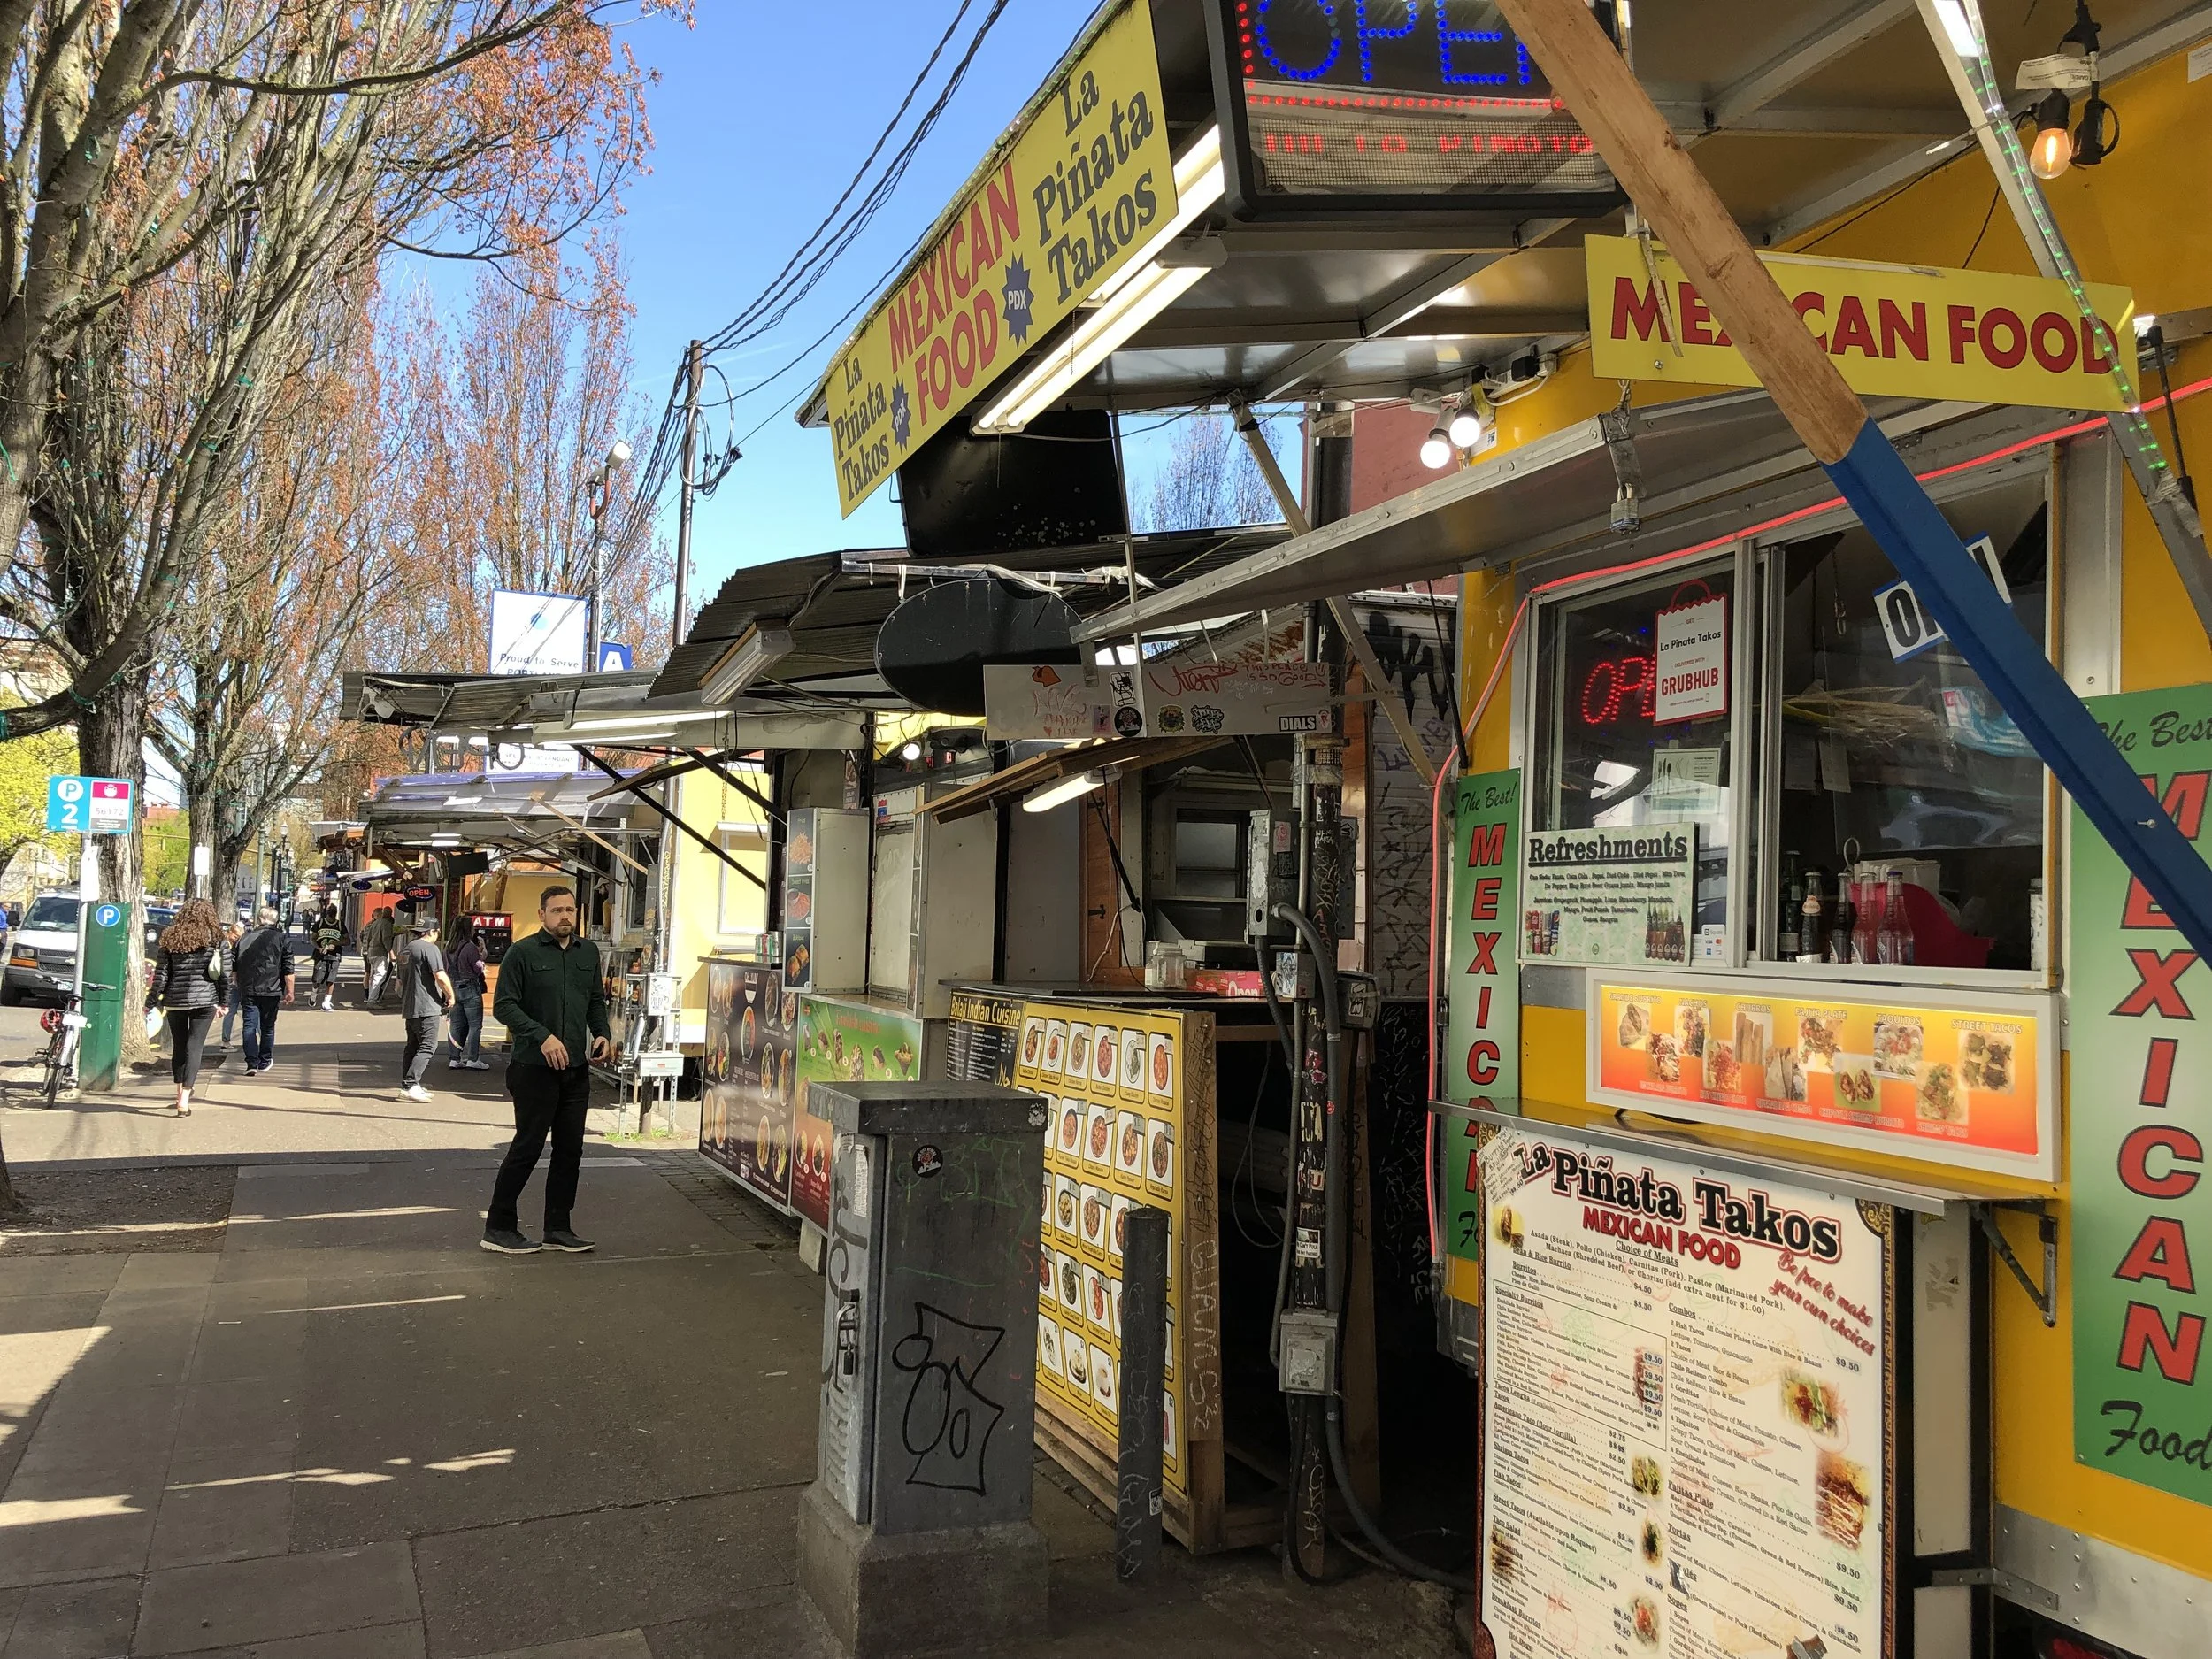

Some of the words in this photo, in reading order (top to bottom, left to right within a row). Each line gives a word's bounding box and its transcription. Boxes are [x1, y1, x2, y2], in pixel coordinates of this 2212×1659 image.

[1062, 68, 1099, 137] La
[1033, 90, 1154, 247] Piñata
[1048, 167, 1157, 306] Takos
[887, 162, 1021, 374] MEXICAN
[1007, 288, 1027, 311] PDX
[1610, 276, 1927, 361] MECAN
[1948, 304, 2119, 374] FOOD
[914, 289, 999, 427] FOOD
[844, 355, 863, 395] La
[833, 379, 887, 461] Piñata
[894, 400, 907, 432] PDX
[841, 433, 890, 502] Takos
[1660, 642, 1669, 651] La
[1698, 631, 1721, 642] Takos
[501, 654, 530, 664] Proud
[551, 658, 579, 668] Serve
[1582, 656, 1655, 723] OPE
[1662, 667, 1719, 696] GRUBHUB
[1280, 717, 1316, 731] DIALS
[66, 783, 77, 797] P
[1461, 788, 1481, 813] The
[1484, 782, 1517, 808] Best!
[61, 803, 78, 824] 2
[1528, 831, 1688, 862] Refreshments
[104, 910, 114, 924] P
[473, 917, 510, 926] ATM
[951, 996, 967, 1022] Balaji
[967, 999, 990, 1022] Indian
[992, 1002, 1021, 1025] Cuisine
[1609, 992, 1634, 1001] GRANDE
[1634, 995, 1662, 1003] BURRITO
[1679, 998, 1708, 1007] NACHOS
[1735, 1002, 1771, 1012] CHURROS
[1795, 1008, 1822, 1018] FAJITA
[1823, 1010, 1847, 1019] PLATE
[1876, 1013, 1921, 1025] TAQUITOS
[1951, 1019, 1986, 1031] STREET
[1990, 1022, 2023, 1033] TACOS
[1916, 1122, 1944, 1134] SHRIMP
[1514, 1147, 1551, 1179] La
[1552, 1151, 1683, 1221] Piñata
[1695, 1182, 1838, 1259] Takos
[1583, 1207, 1672, 1253] MEXICAN
[1679, 1232, 1741, 1271] FOOD
[1615, 1240, 1641, 1255] Choice
[1644, 1248, 1653, 1257] of
[1655, 1251, 1679, 1266] Meats
[1512, 1261, 1537, 1274] Burritos
[1530, 1229, 1548, 1240] Asada
[1549, 1234, 1575, 1250] (Steak),
[1576, 1242, 1592, 1253] Pollo
[1629, 1258, 1659, 1273] Carnitas
[1661, 1266, 1686, 1282] (Pork),
[1688, 1275, 1713, 1289] Pastor
[1715, 1282, 1758, 1302] (Marinated
[1760, 1295, 1786, 1312] Pork),
[1534, 1252, 1548, 1263] Rice
[1549, 1255, 1571, 1270] Burrito
[1633, 1282, 1652, 1294] $4.50
[1545, 1242, 1572, 1256] Machaca
[1573, 1251, 1605, 1267] (Shredded
[1637, 1271, 1664, 1286] Chorizo
[1665, 1278, 1682, 1291] (add
[1683, 1284, 1703, 1297] extra
[1705, 1291, 1724, 1303] meat
[1726, 1296, 1738, 1307] for
[1740, 1302, 1765, 1317] $1.00)
[1495, 1286, 1519, 1302] Specialty
[1520, 1294, 1543, 1308] Burritos
[1595, 1297, 1611, 1308] Cream
[1778, 1250, 1798, 1276] Be
[1823, 1281, 1835, 1302] to
[1836, 1295, 1874, 1327] make
[1675, 1321, 1687, 1331] Fish
[1688, 1325, 1705, 1337] Tacos
[1768, 1279, 1802, 1305] your
[1803, 1299, 1829, 1324] own
[1830, 1317, 1875, 1356] choices
[1668, 1302, 1696, 1319] Combos
[1835, 1356, 1860, 1372] $9.50
[1714, 1326, 1732, 1339] Combo
[1733, 1333, 1751, 1345] Plates
[1752, 1339, 1768, 1351] Come
[1769, 1344, 1782, 1355] With
[1783, 1350, 1796, 1361] Rice
[1804, 1356, 1822, 1368] Beans
[1644, 1352, 1663, 1364] $9.50
[1722, 1347, 1754, 1363] Guacamole
[1645, 1371, 1663, 1383] $9.50
[1671, 1362, 1685, 1371] Chile
[1686, 1366, 1707, 1379] Relleno
[1708, 1374, 1728, 1388] Combo
[1645, 1389, 1663, 1402] $9.50
[1675, 1384, 1700, 1399] Gorditas
[1494, 1381, 1509, 1393] Tacos
[1510, 1386, 1531, 1401] Lengua
[1609, 1430, 1626, 1442] $2.75
[1494, 1402, 1522, 1418] Americano
[1523, 1414, 1535, 1426] Taco
[1554, 1425, 1578, 1444] tortilla)
[1644, 1404, 1663, 1417] $9.50
[1675, 1417, 1700, 1432] Taquitos
[2101, 1400, 2212, 1471] Food
[1668, 1480, 1693, 1499] Fajitas
[1694, 1494, 1714, 1508] Plate
[1836, 1562, 1861, 1579] $9.50
[1668, 1523, 1691, 1541] Tortas
[1833, 1594, 1858, 1613] $9.50
